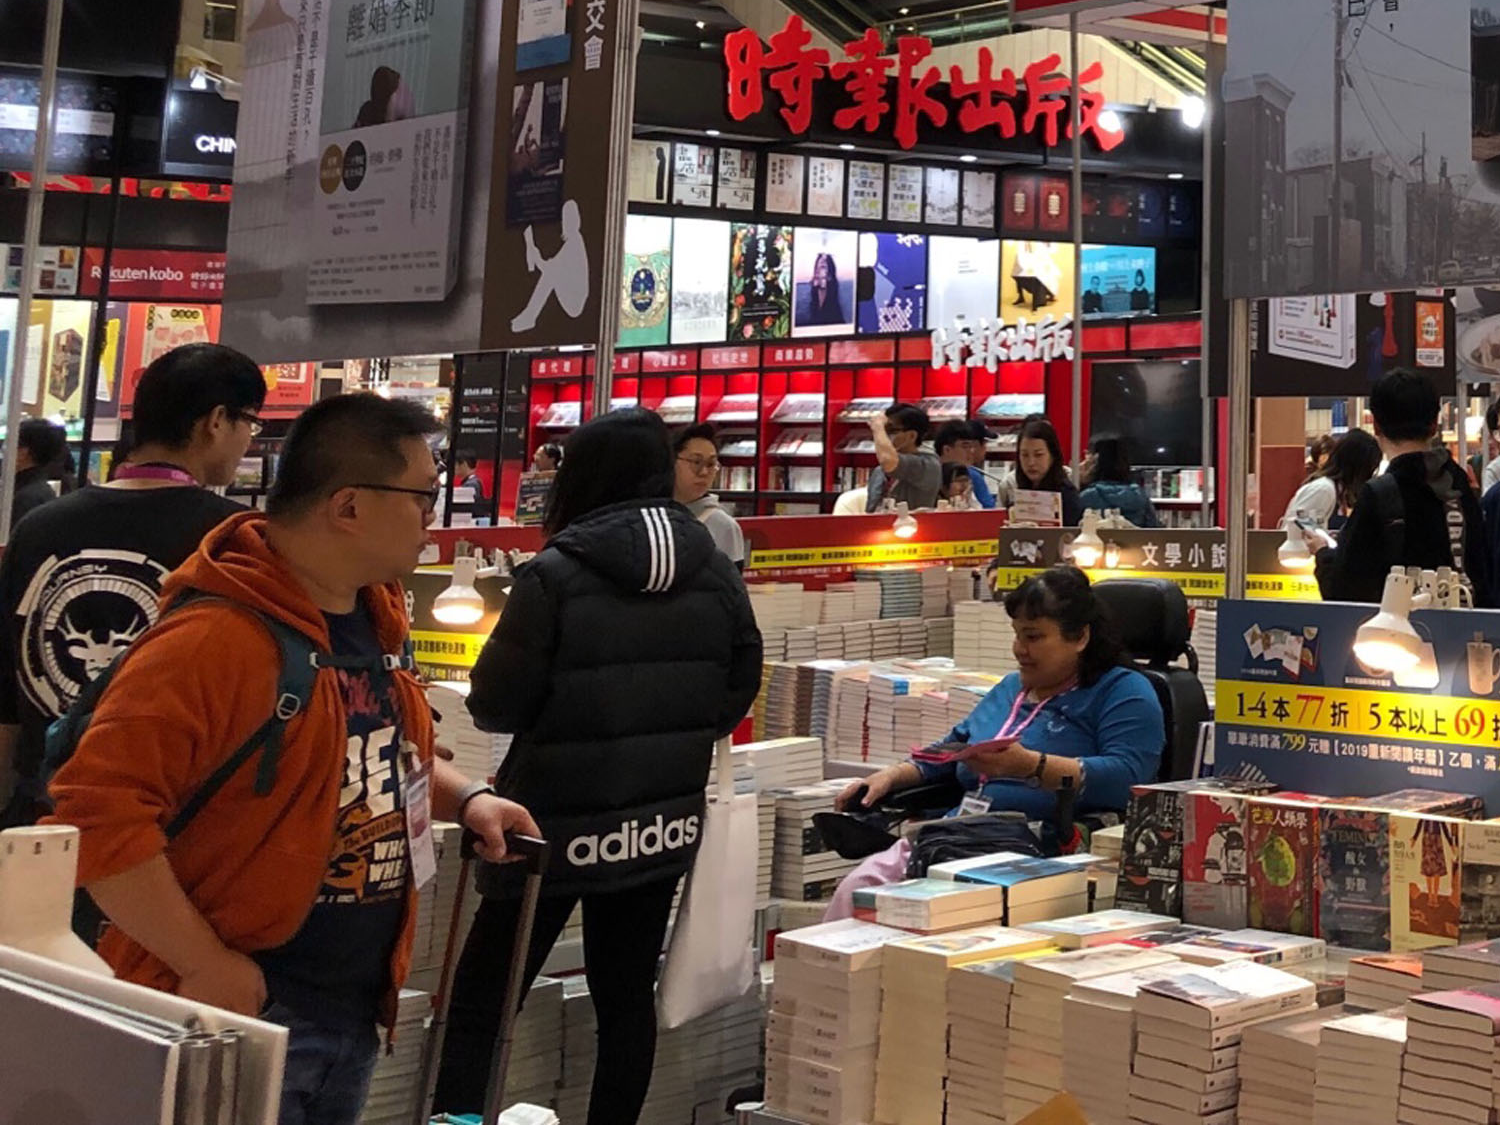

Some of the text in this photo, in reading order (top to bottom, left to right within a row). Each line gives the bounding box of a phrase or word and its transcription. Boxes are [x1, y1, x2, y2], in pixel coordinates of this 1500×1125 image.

[722, 14, 1125, 152] 時報出版
[91, 265, 148, 282] Rkuten
[149, 265, 184, 281] kobo
[930, 312, 1075, 374] 時報出版
[1141, 542, 1227, 569] 文學小說
[567, 813, 699, 869] adidas
